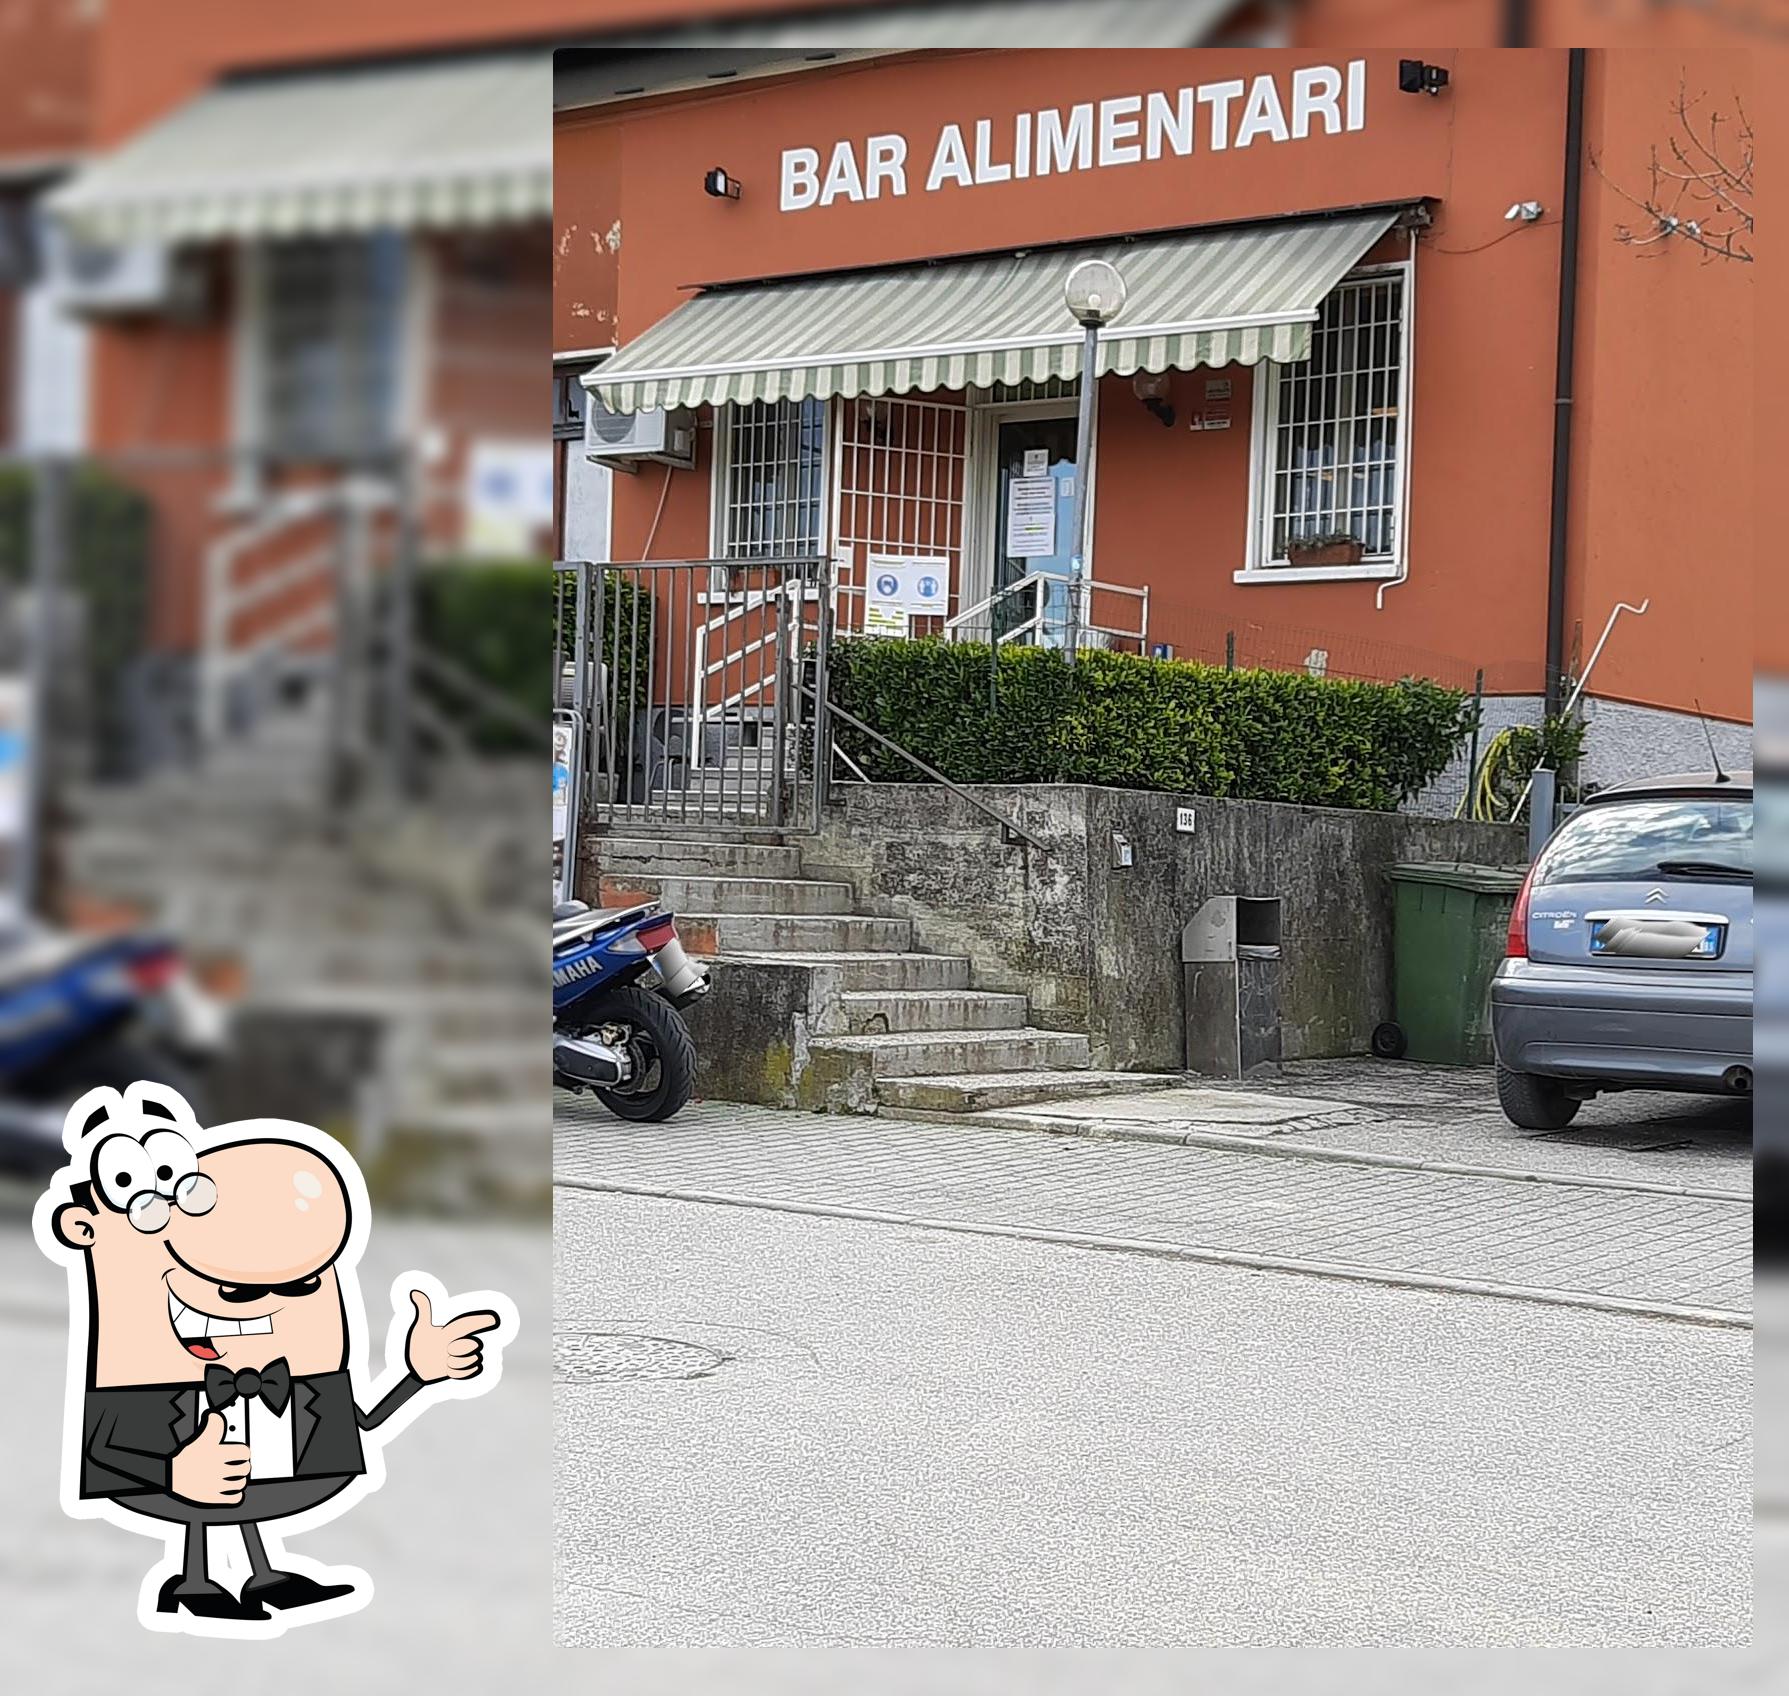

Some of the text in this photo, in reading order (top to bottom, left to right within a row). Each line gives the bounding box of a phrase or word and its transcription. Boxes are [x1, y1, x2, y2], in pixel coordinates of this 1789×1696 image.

[779, 59, 1367, 212] BAR ALIMENTARI
[1179, 811, 1193, 826] 136
